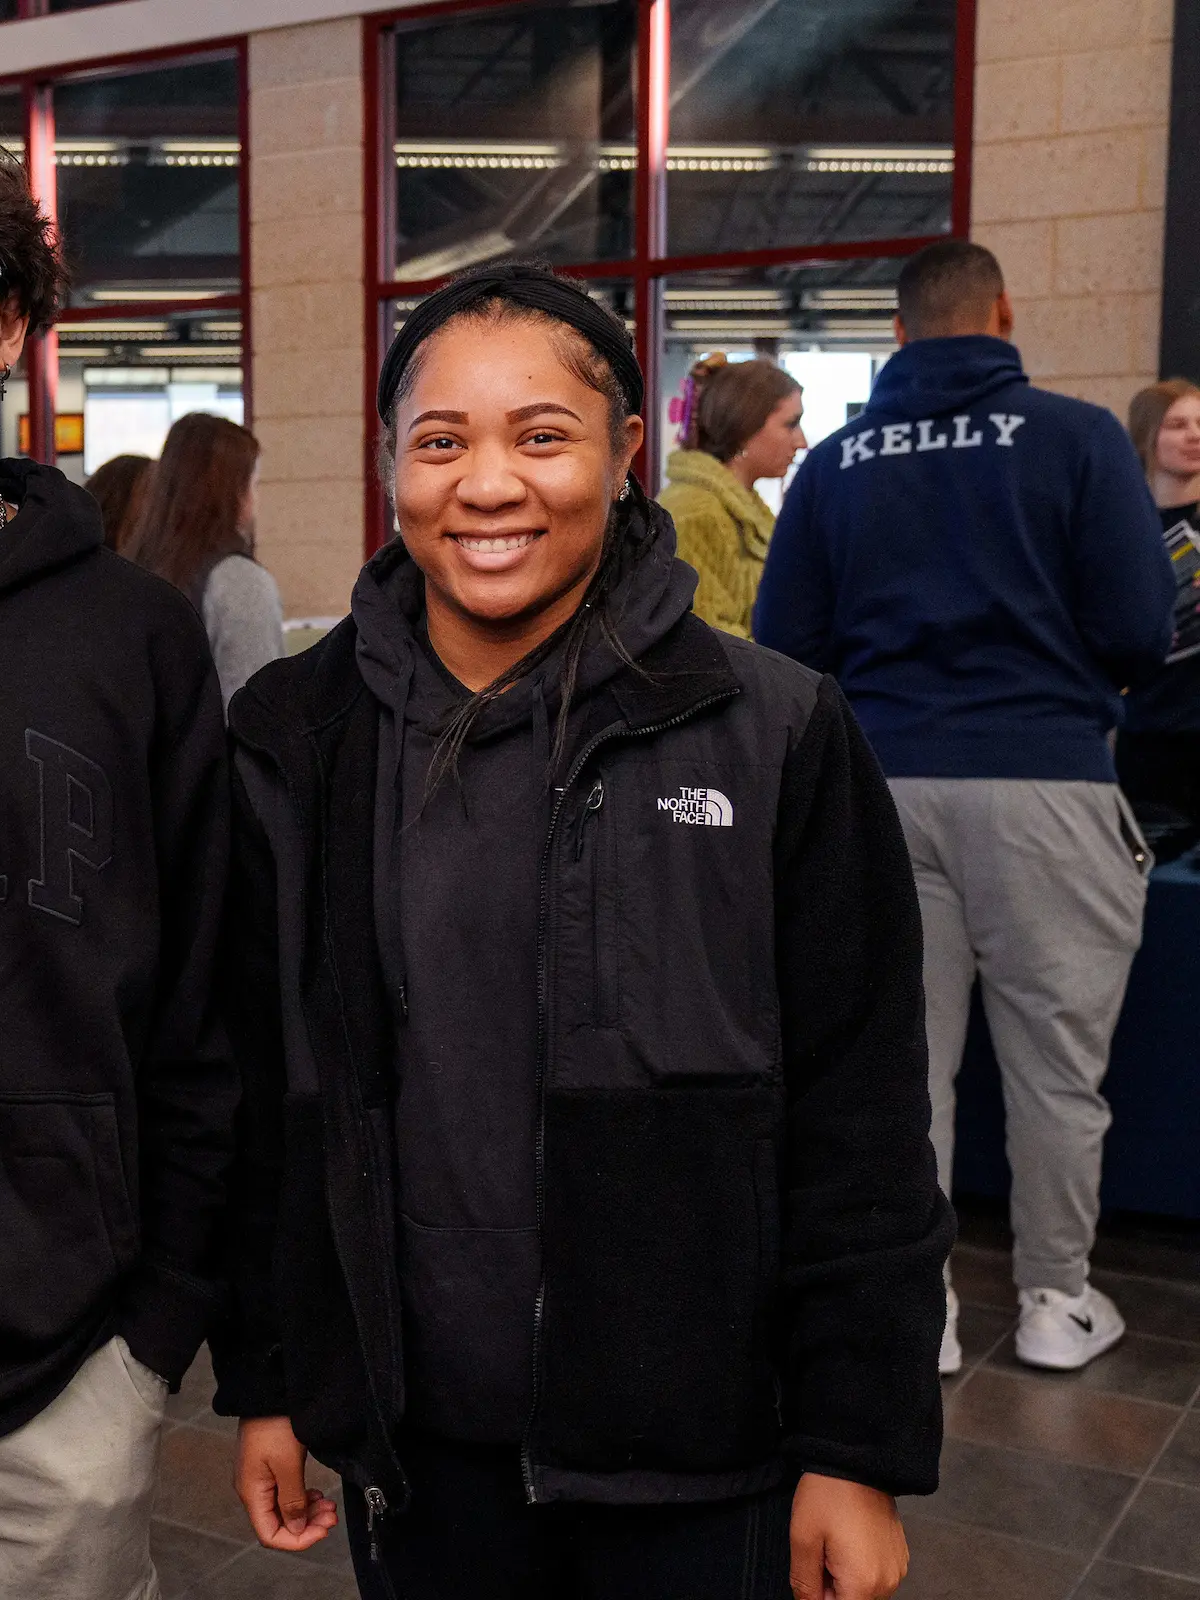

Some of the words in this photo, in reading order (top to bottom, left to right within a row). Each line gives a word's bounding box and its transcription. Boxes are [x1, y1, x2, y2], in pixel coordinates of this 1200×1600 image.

[839, 413, 1026, 470] KELLY
[679, 786, 707, 801] THE
[657, 797, 706, 813] NORTH
[673, 810, 706, 825] FACE
